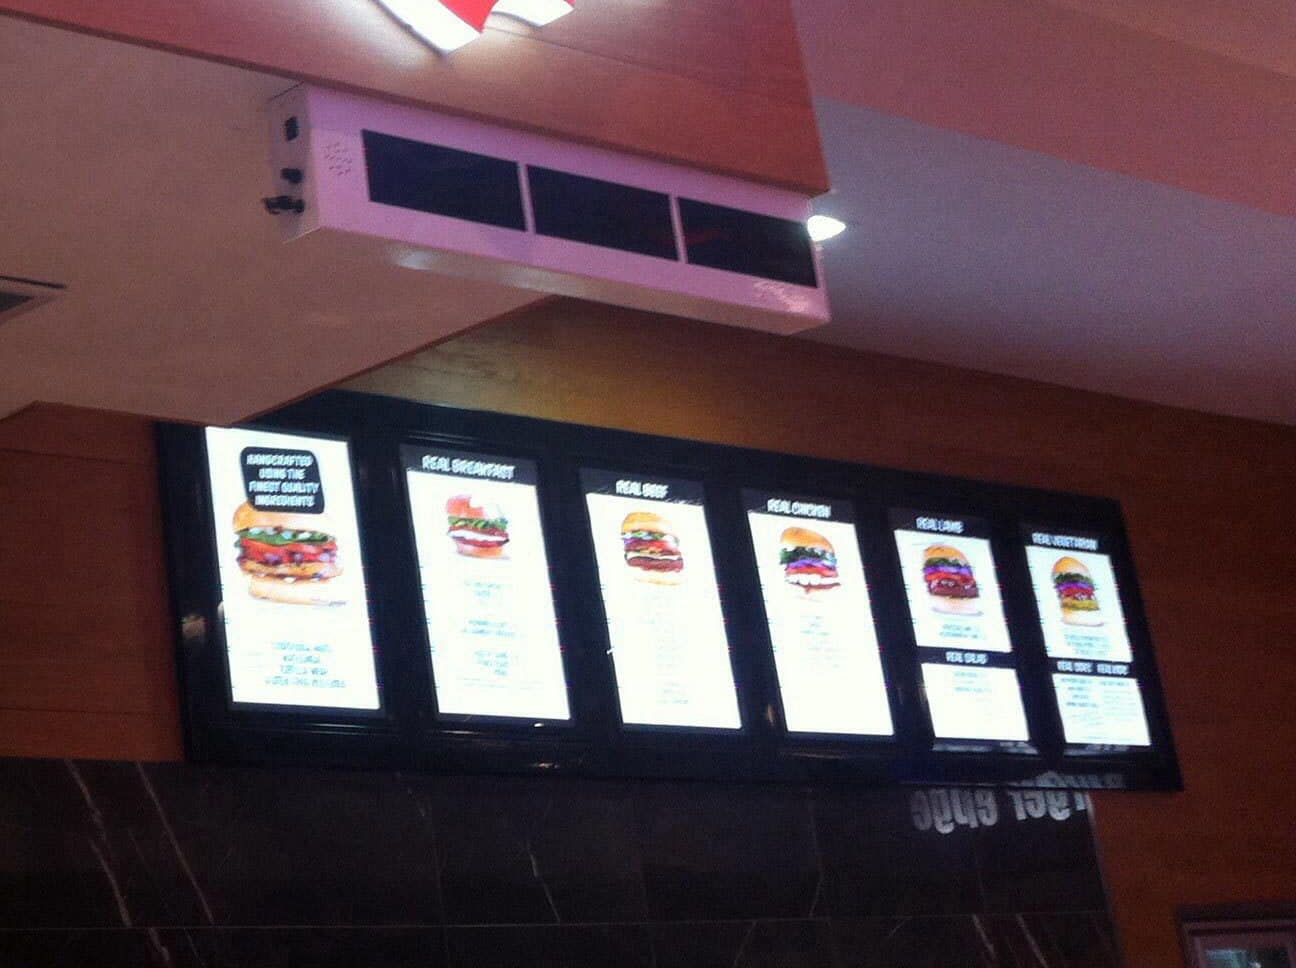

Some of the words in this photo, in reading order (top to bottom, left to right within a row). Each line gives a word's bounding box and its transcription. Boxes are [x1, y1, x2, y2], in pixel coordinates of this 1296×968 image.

[246, 453, 313, 468] HANDCRAFTED
[422, 454, 451, 472] REAL
[451, 458, 516, 480] BREAKFAST
[287, 467, 306, 480] THE
[248, 479, 282, 493] FINEST
[281, 480, 320, 494] QUALITY
[615, 479, 642, 496] REAL
[254, 493, 316, 507] INGREDIENTS
[767, 497, 792, 514] REAL
[791, 500, 832, 519] CHICKEN
[915, 515, 938, 531] REAL
[1031, 531, 1051, 546] REAL
